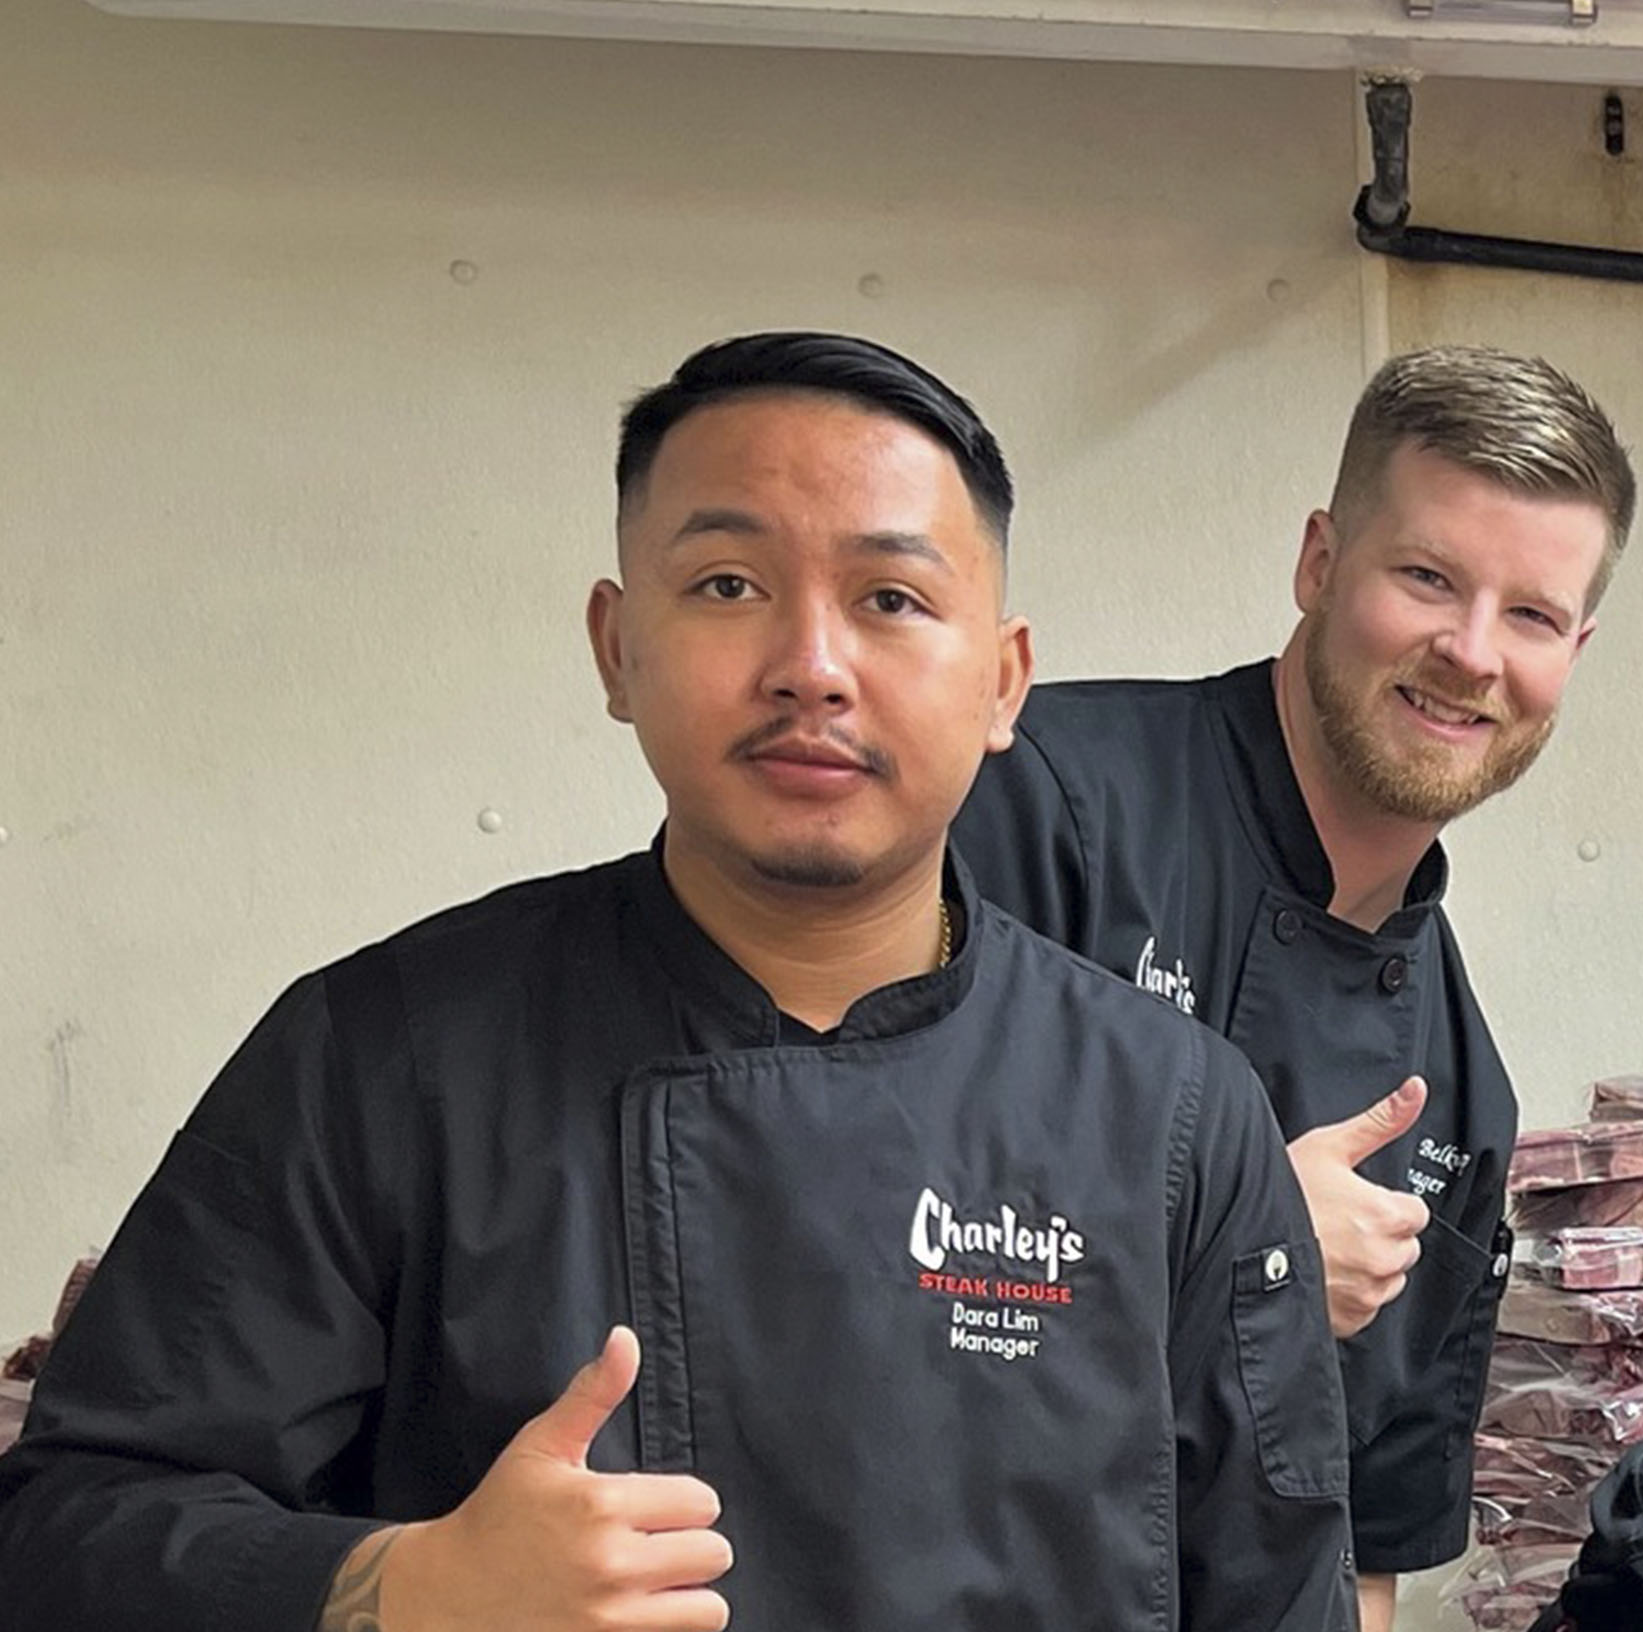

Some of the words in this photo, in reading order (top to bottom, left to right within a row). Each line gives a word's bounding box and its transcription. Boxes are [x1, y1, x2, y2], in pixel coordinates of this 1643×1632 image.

[910, 1188, 1084, 1282] Charley's
[919, 1273, 988, 1297] STEAK
[997, 1281, 1073, 1304] HOUSE
[953, 1302, 999, 1328] Dara
[1003, 1308, 1040, 1331] Lim
[950, 1328, 1040, 1360] Manager
